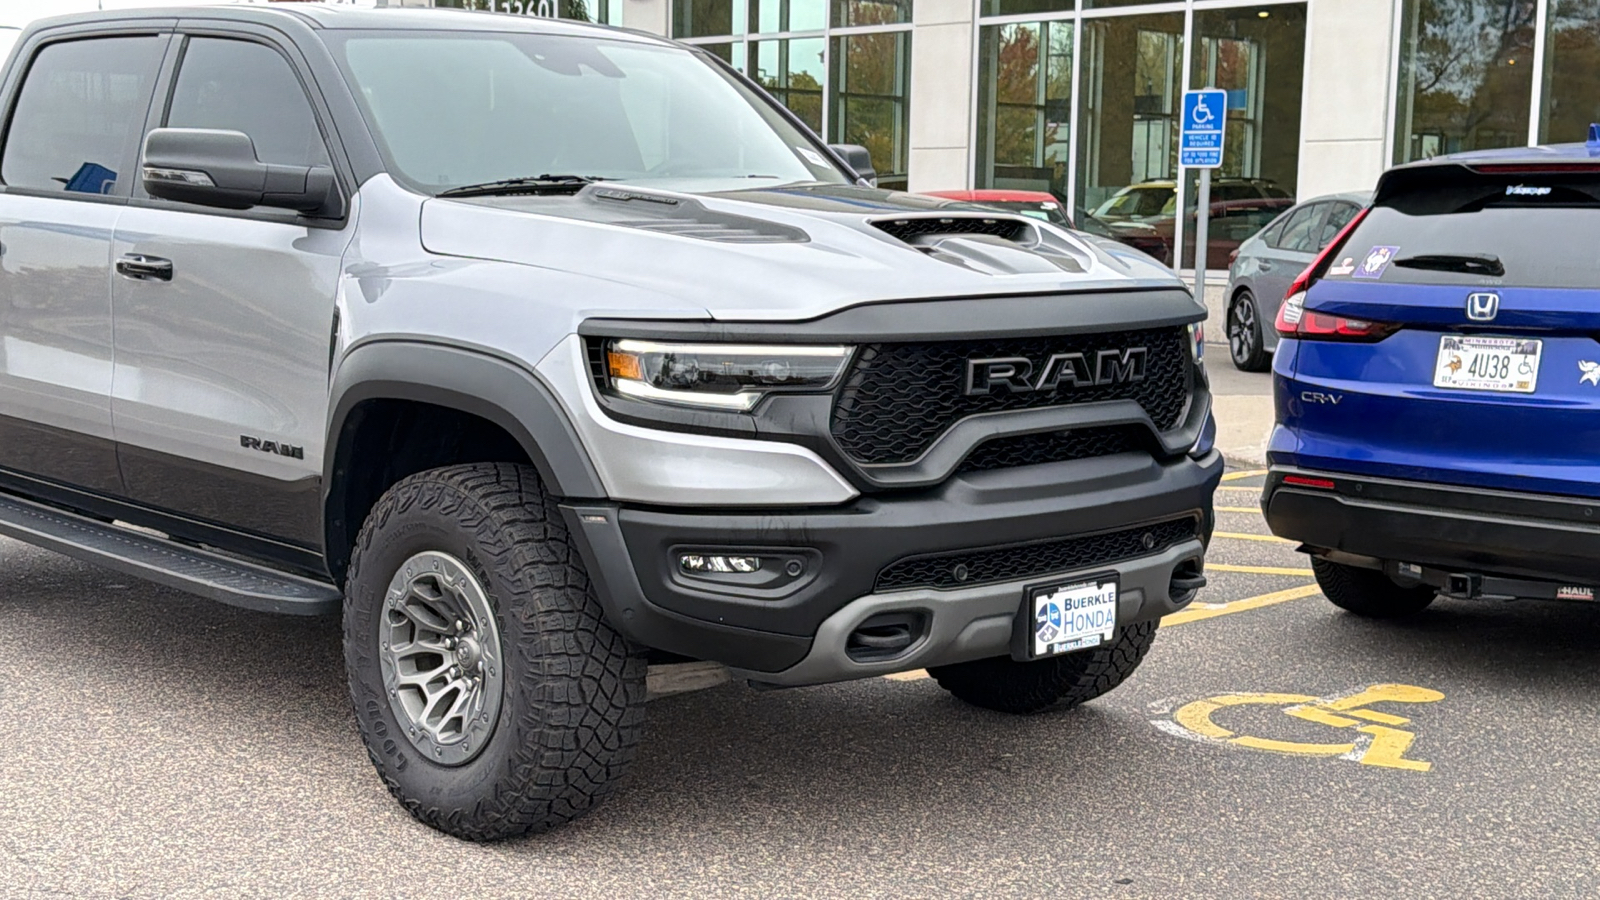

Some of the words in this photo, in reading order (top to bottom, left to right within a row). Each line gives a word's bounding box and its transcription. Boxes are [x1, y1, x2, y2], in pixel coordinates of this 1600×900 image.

[1464, 338, 1515, 346] MINNESOTA
[967, 347, 1147, 396] RAM
[1468, 353, 1511, 380] 4U38
[1301, 391, 1343, 404] CR-V
[240, 434, 304, 460] RAM
[1064, 591, 1115, 612] BUERKLE
[1063, 608, 1114, 635] HONDA
